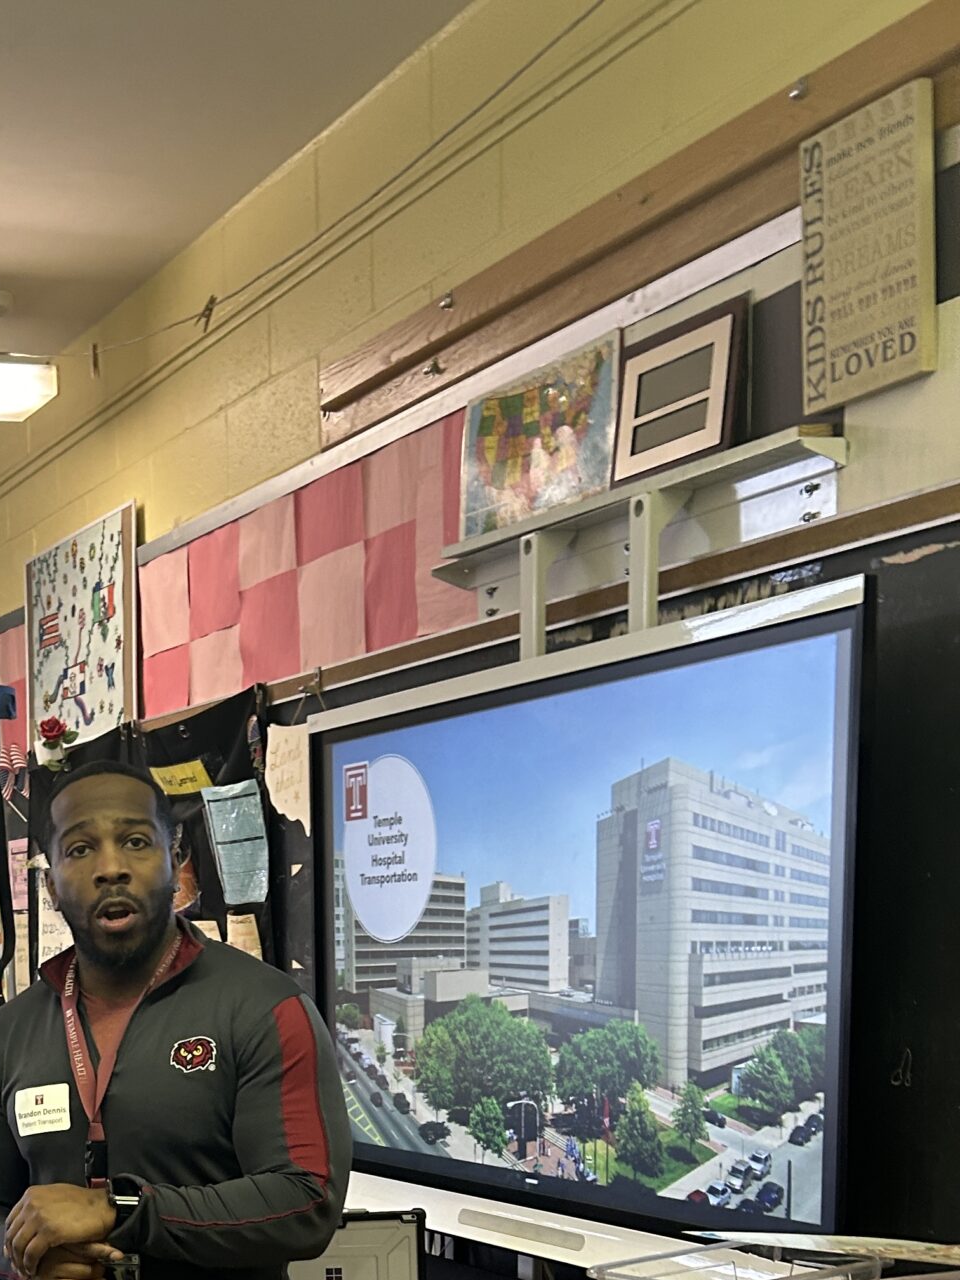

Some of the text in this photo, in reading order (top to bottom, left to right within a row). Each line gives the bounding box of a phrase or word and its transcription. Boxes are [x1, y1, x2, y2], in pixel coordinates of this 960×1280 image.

[803, 141, 826, 406] KIDS RULES
[830, 331, 917, 384] LOVED
[373, 812, 403, 830] Temple
[368, 830, 409, 847] University
[371, 851, 406, 870] Hospital
[360, 868, 418, 888] Transportation
[18, 1106, 67, 1120] Brandon Dennis
